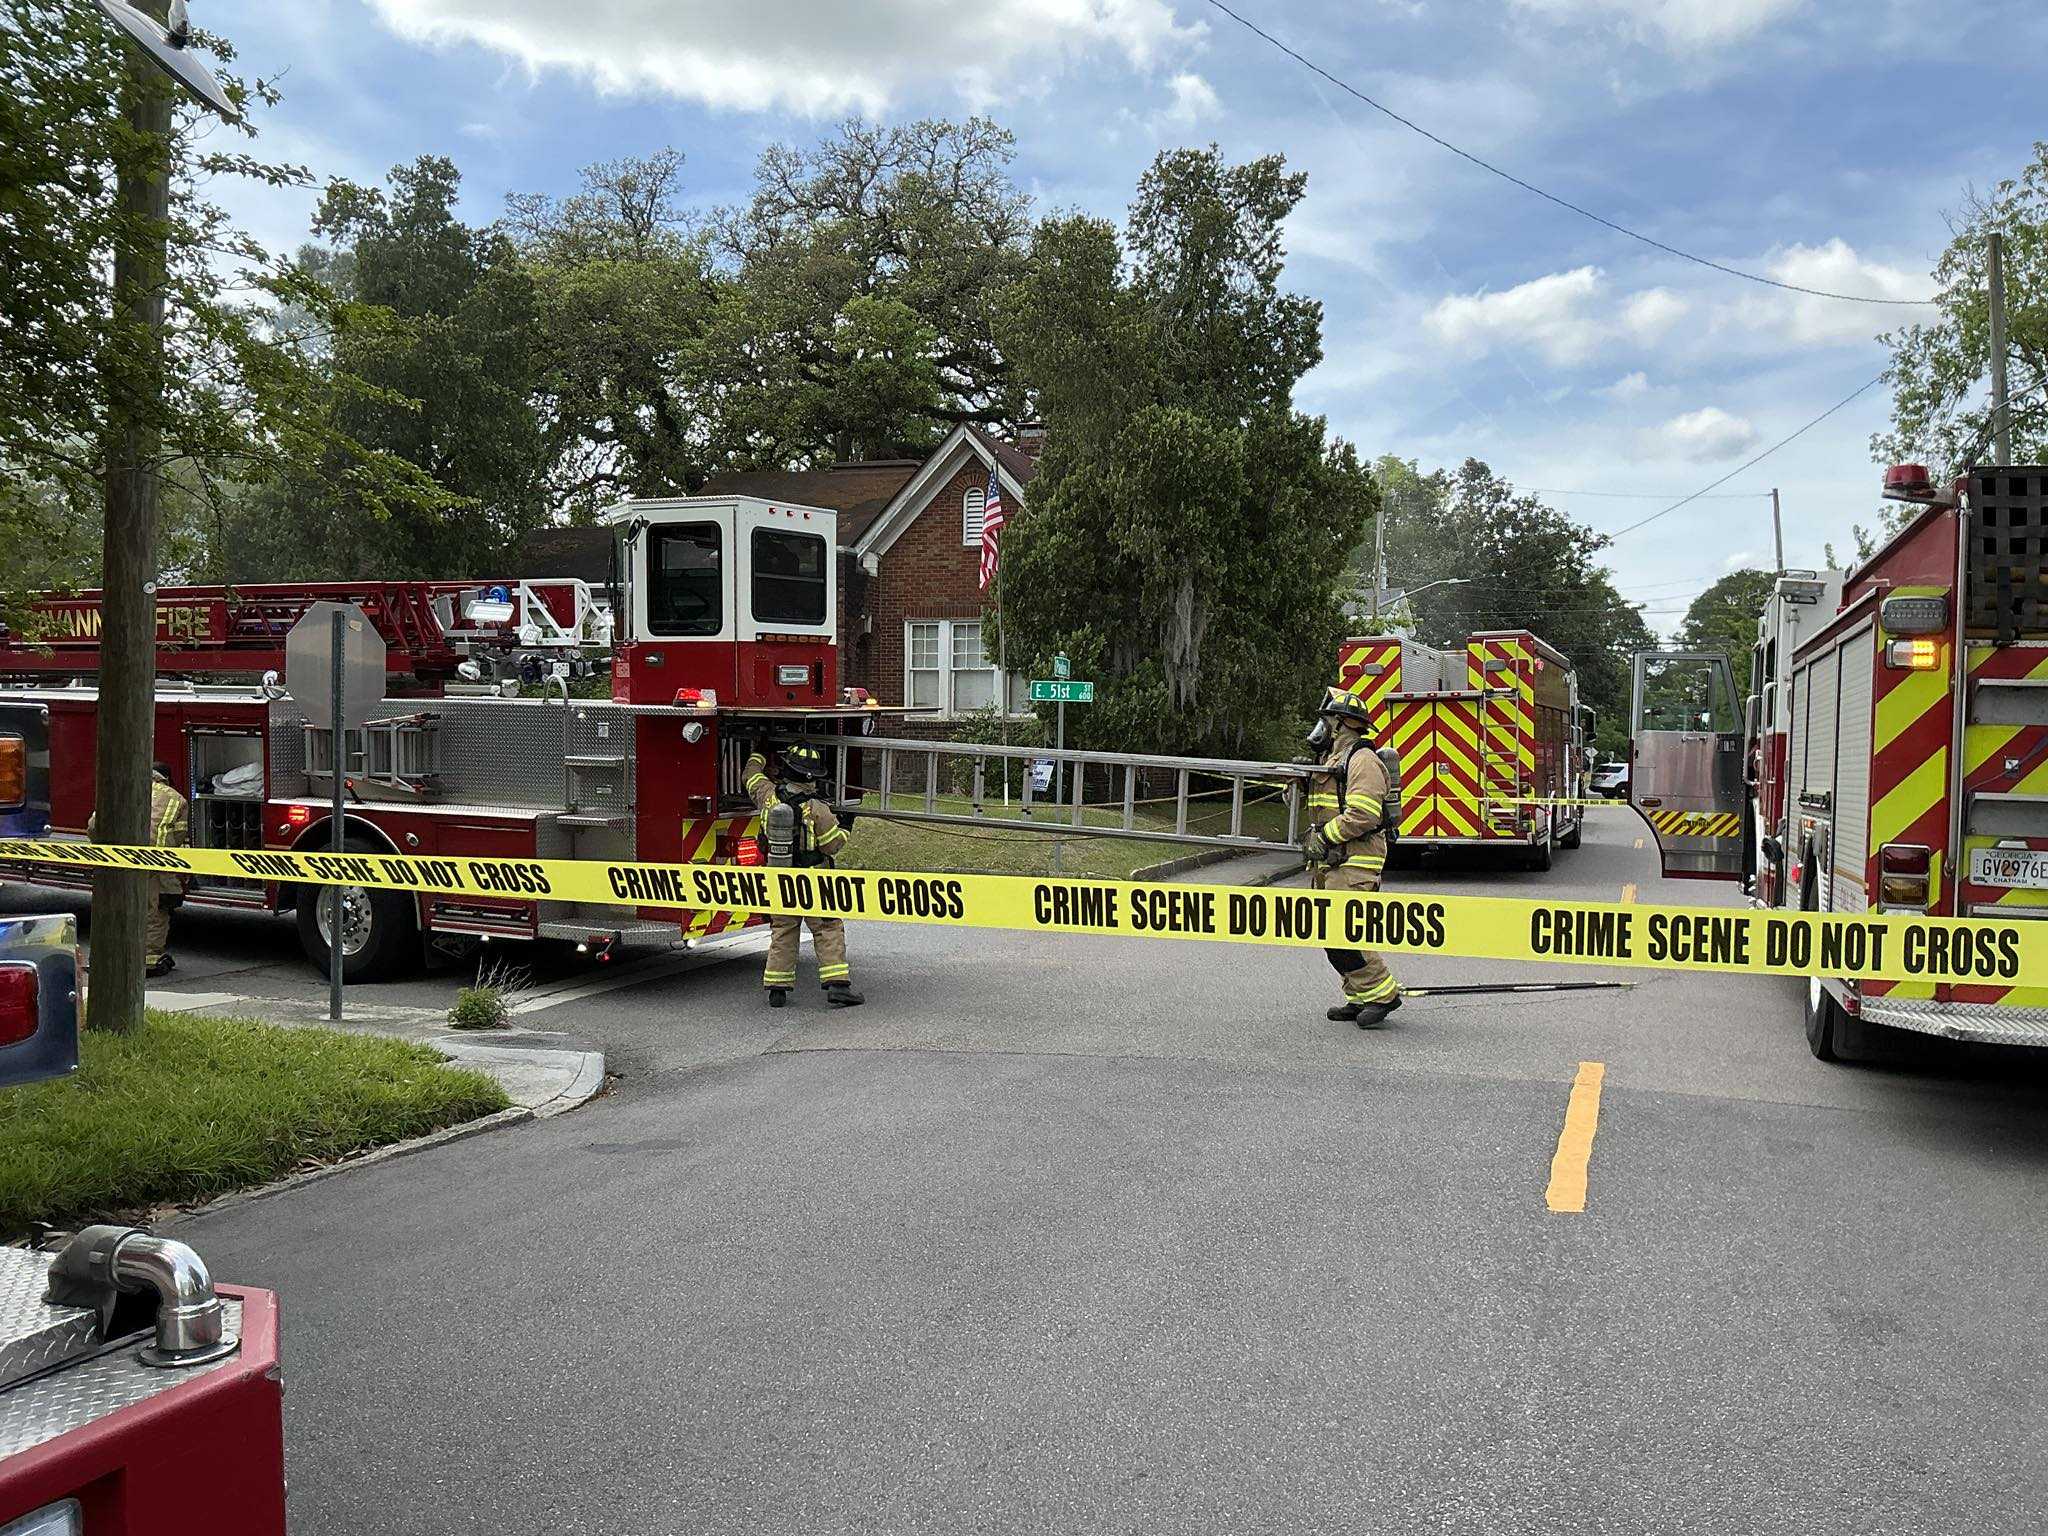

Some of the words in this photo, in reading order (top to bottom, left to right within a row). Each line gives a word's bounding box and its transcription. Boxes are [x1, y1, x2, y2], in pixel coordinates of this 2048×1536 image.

[155, 606, 211, 637] FIRE
[1050, 684, 1070, 699] 51st
[1078, 692, 1091, 700] 600
[38, 844, 80, 860] DO
[66, 845, 119, 863] NOT
[112, 848, 191, 869] CROSS
[230, 852, 308, 877] CRIME
[303, 856, 382, 882] SCENE
[378, 859, 418, 885] DO
[413, 860, 465, 888] NOT
[468, 861, 552, 894] CROSS
[607, 866, 687, 902] CRIME
[692, 869, 770, 907] SCENE
[778, 873, 813, 910] DO
[818, 875, 866, 913] NOT
[877, 878, 964, 920] CROSS
[1034, 884, 1119, 928] CRIME
[1130, 888, 1216, 933] SCENE
[1229, 894, 1267, 937] DO
[1275, 896, 1331, 941] NOT
[1344, 899, 1445, 948] CROSS
[1531, 908, 1633, 958] CRIME
[1647, 914, 1750, 965] SCENE
[1766, 920, 1812, 968] DO
[1820, 921, 1888, 972] NOT
[1903, 924, 2019, 978] CROSS
